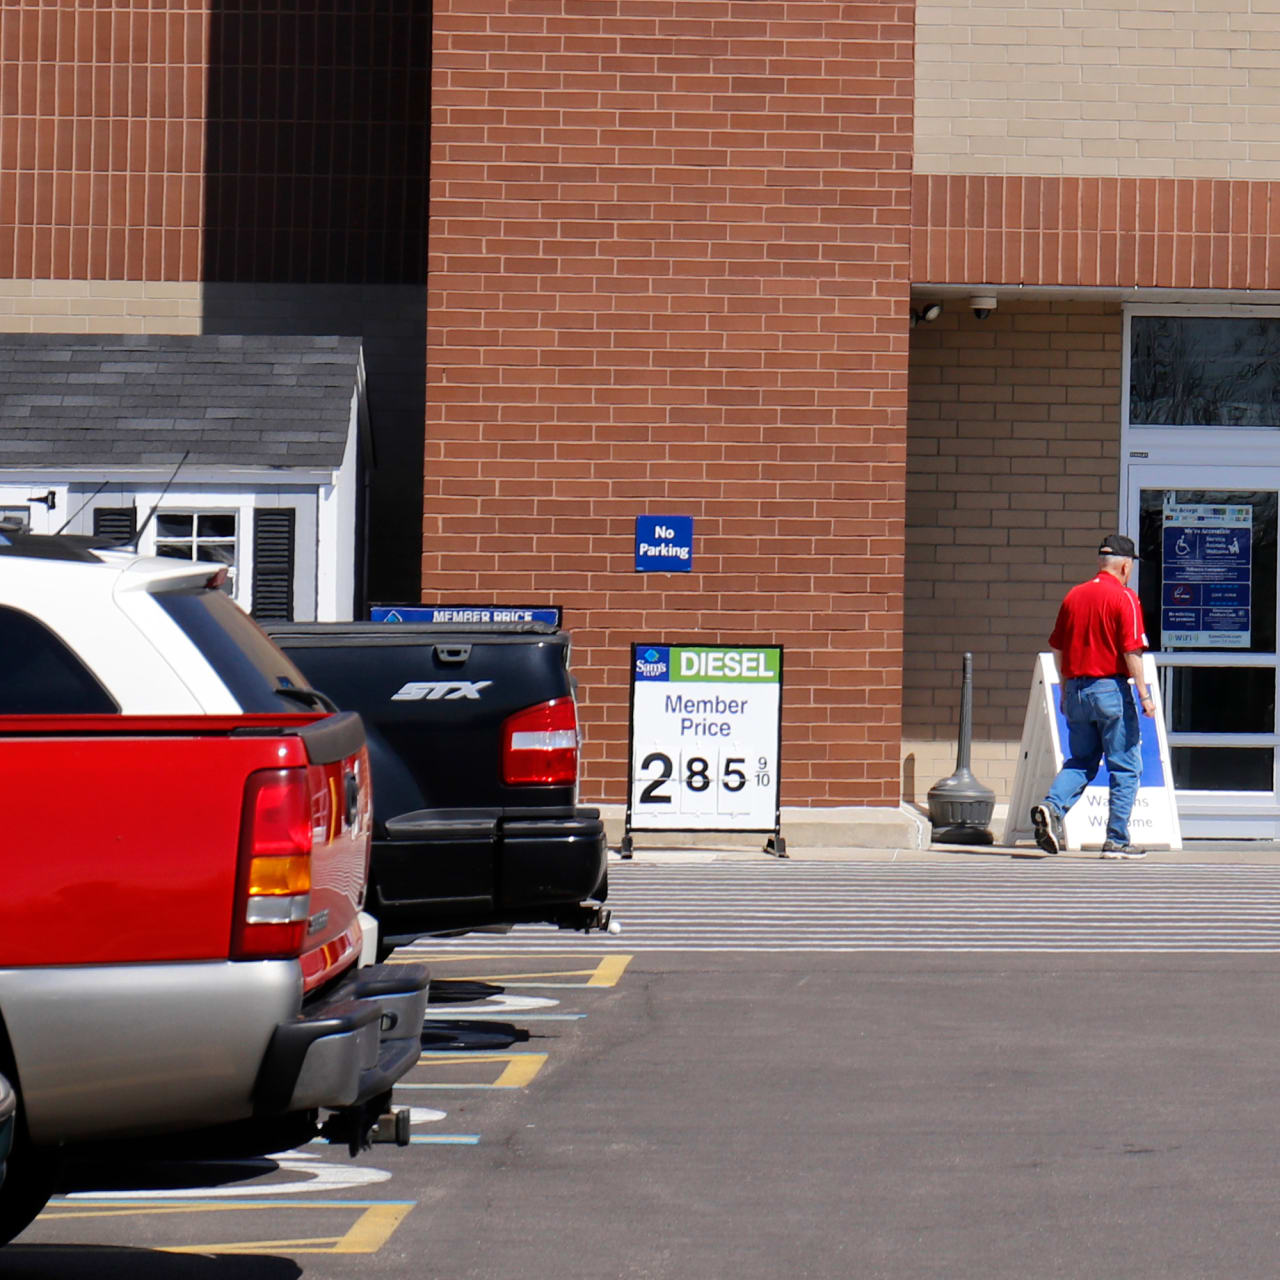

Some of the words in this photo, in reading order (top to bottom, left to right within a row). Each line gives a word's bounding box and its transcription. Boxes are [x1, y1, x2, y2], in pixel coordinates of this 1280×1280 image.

[654, 525, 675, 539] No
[639, 543, 690, 560] Parking
[433, 610, 491, 623] MEMBER
[493, 611, 533, 623] PRICE
[636, 659, 667, 674] Sam's
[680, 651, 775, 678] DIESEL
[391, 680, 494, 701] STX
[665, 694, 749, 715] Member
[680, 717, 732, 738] Price
